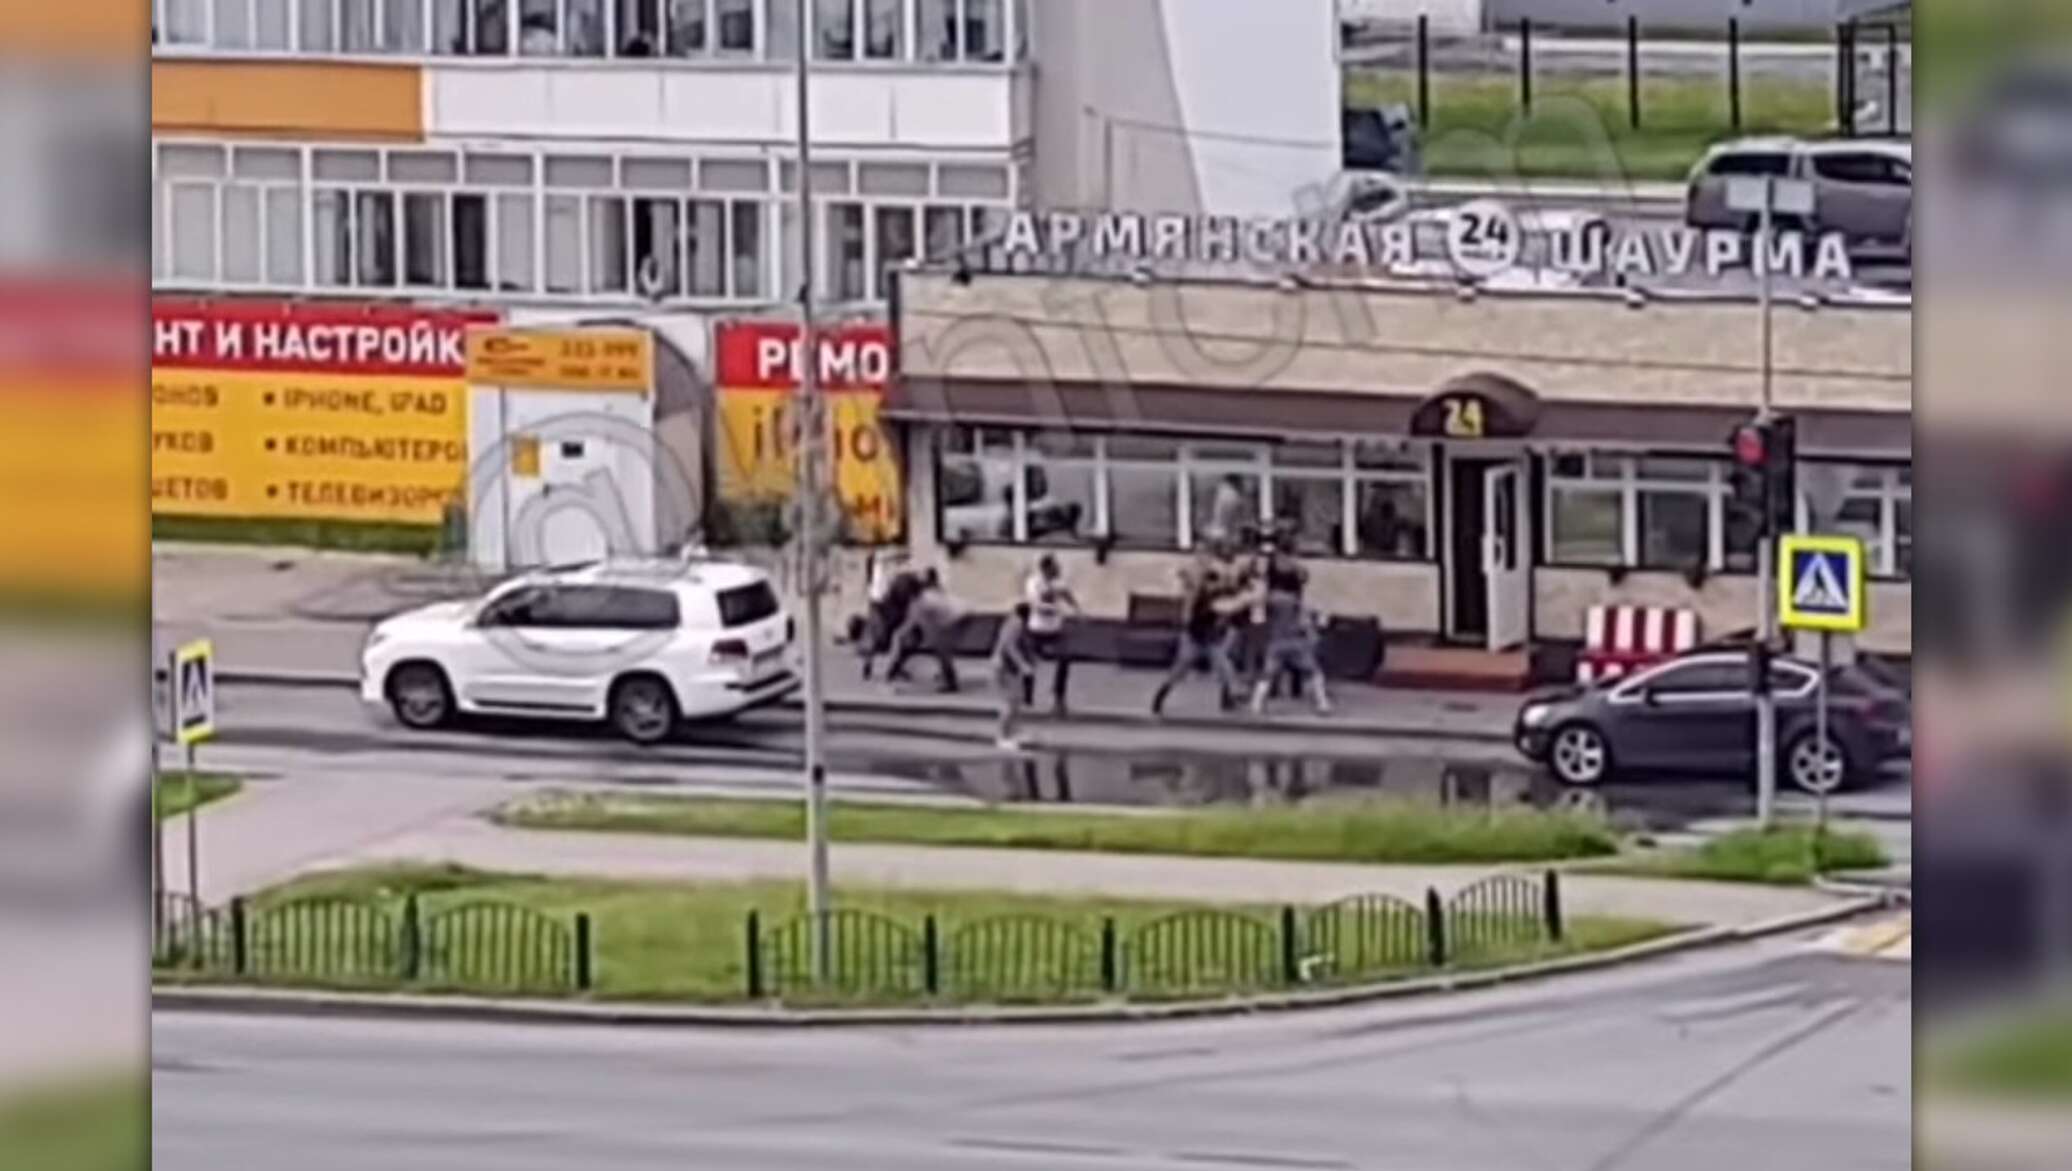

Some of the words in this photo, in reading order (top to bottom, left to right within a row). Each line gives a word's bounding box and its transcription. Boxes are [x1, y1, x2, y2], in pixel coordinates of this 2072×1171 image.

[1004, 209, 1414, 265] АРМЯНСКАЯ
[1459, 211, 1508, 246] 24
[1551, 225, 1850, 278] ШАУРМА
[155, 319, 204, 357] НТ
[214, 320, 243, 360] И
[253, 319, 465, 365] НАСТРОЙК
[1442, 397, 1483, 437] 24
